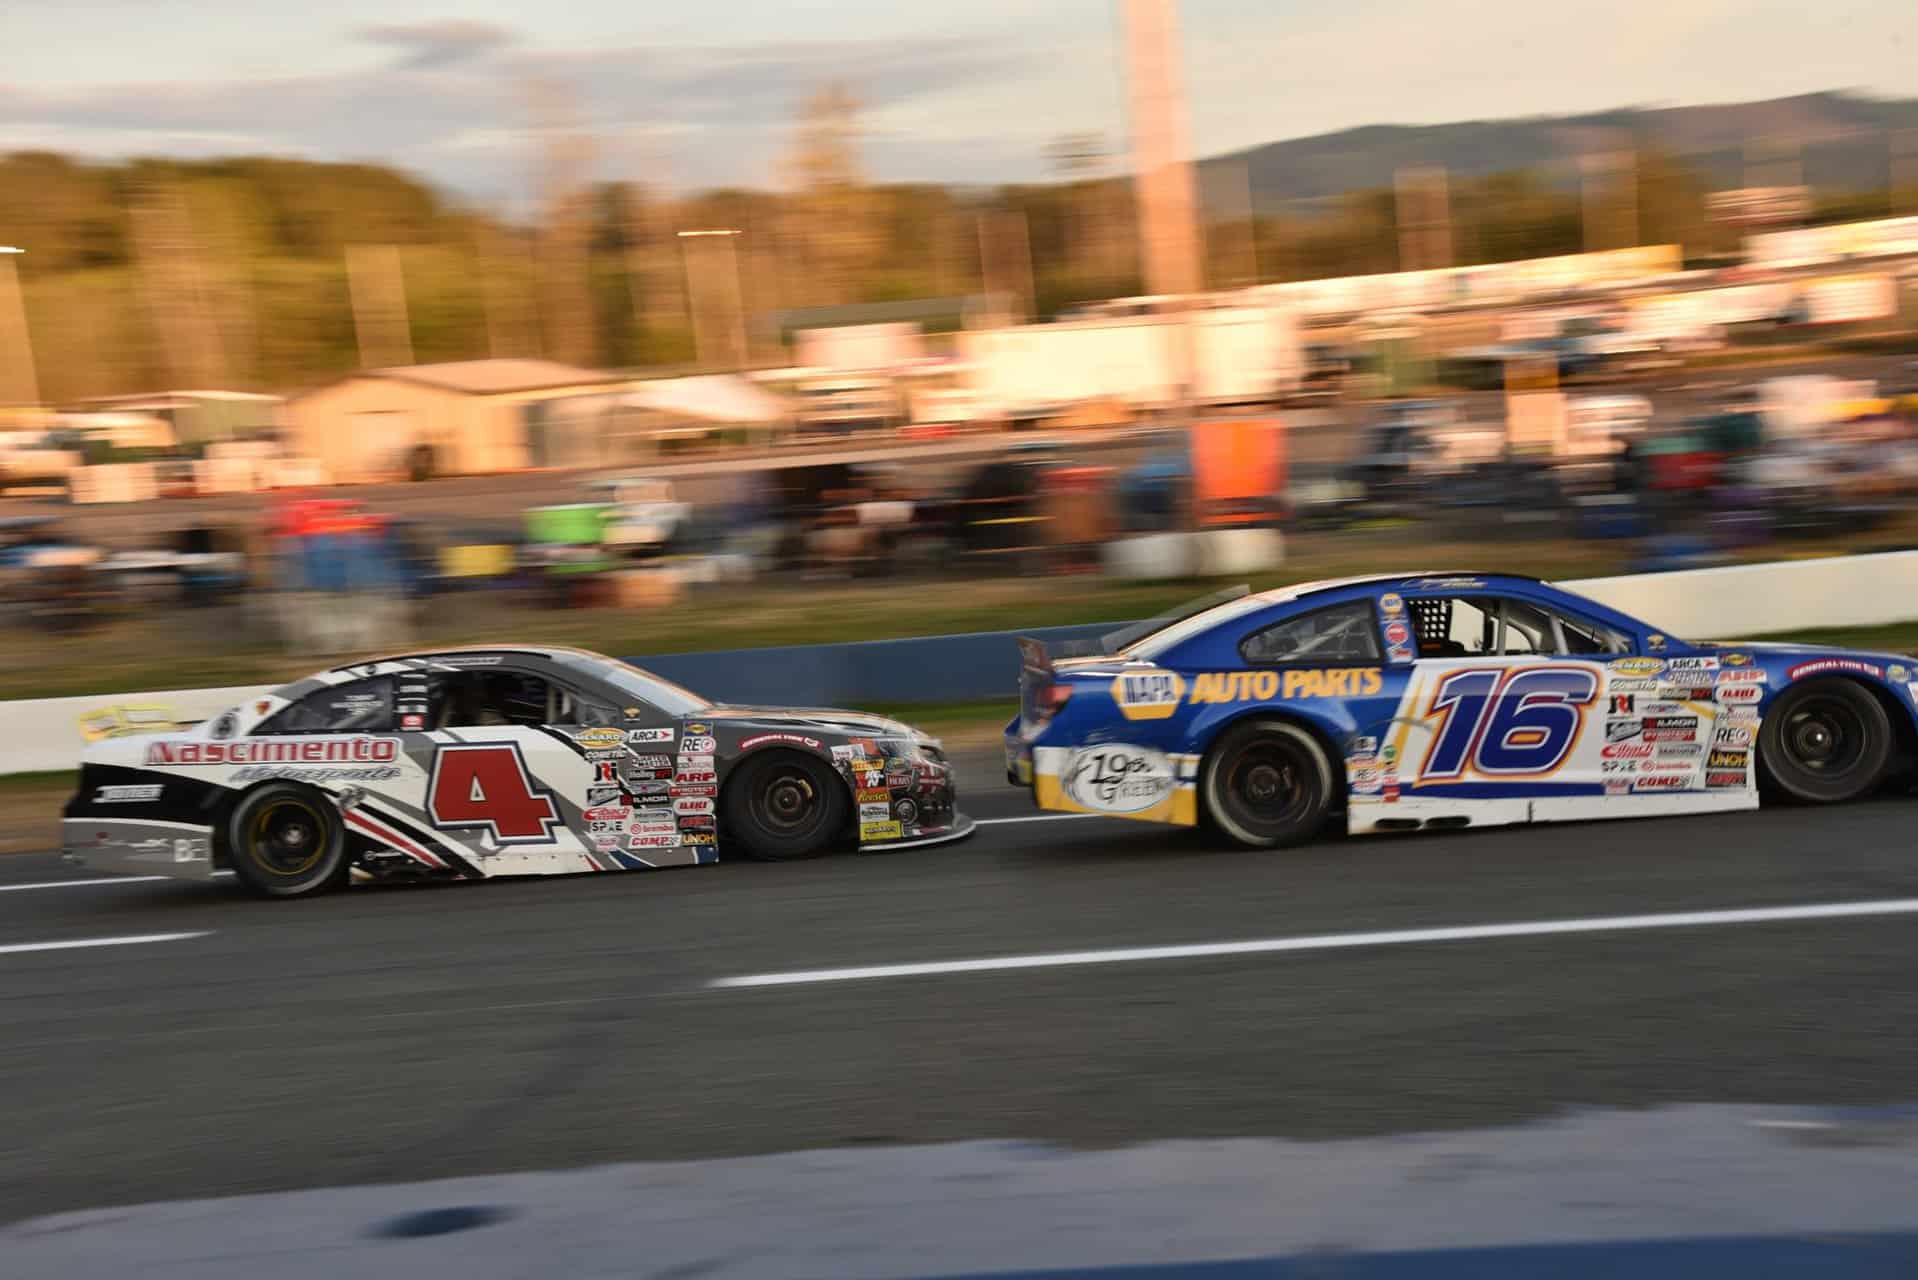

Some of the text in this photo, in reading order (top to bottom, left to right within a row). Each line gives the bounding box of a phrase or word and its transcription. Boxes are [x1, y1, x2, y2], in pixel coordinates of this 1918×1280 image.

[1189, 668, 1383, 704] AUTO PARTS
[1412, 664, 1601, 788] 16
[632, 731, 657, 740] ARCA
[148, 739, 396, 763] Nascimento
[674, 772, 716, 783] ARP
[1638, 776, 1681, 787] COMP
[425, 741, 559, 845] 4
[630, 836, 669, 846] COMP
[683, 833, 714, 844] UNOH
